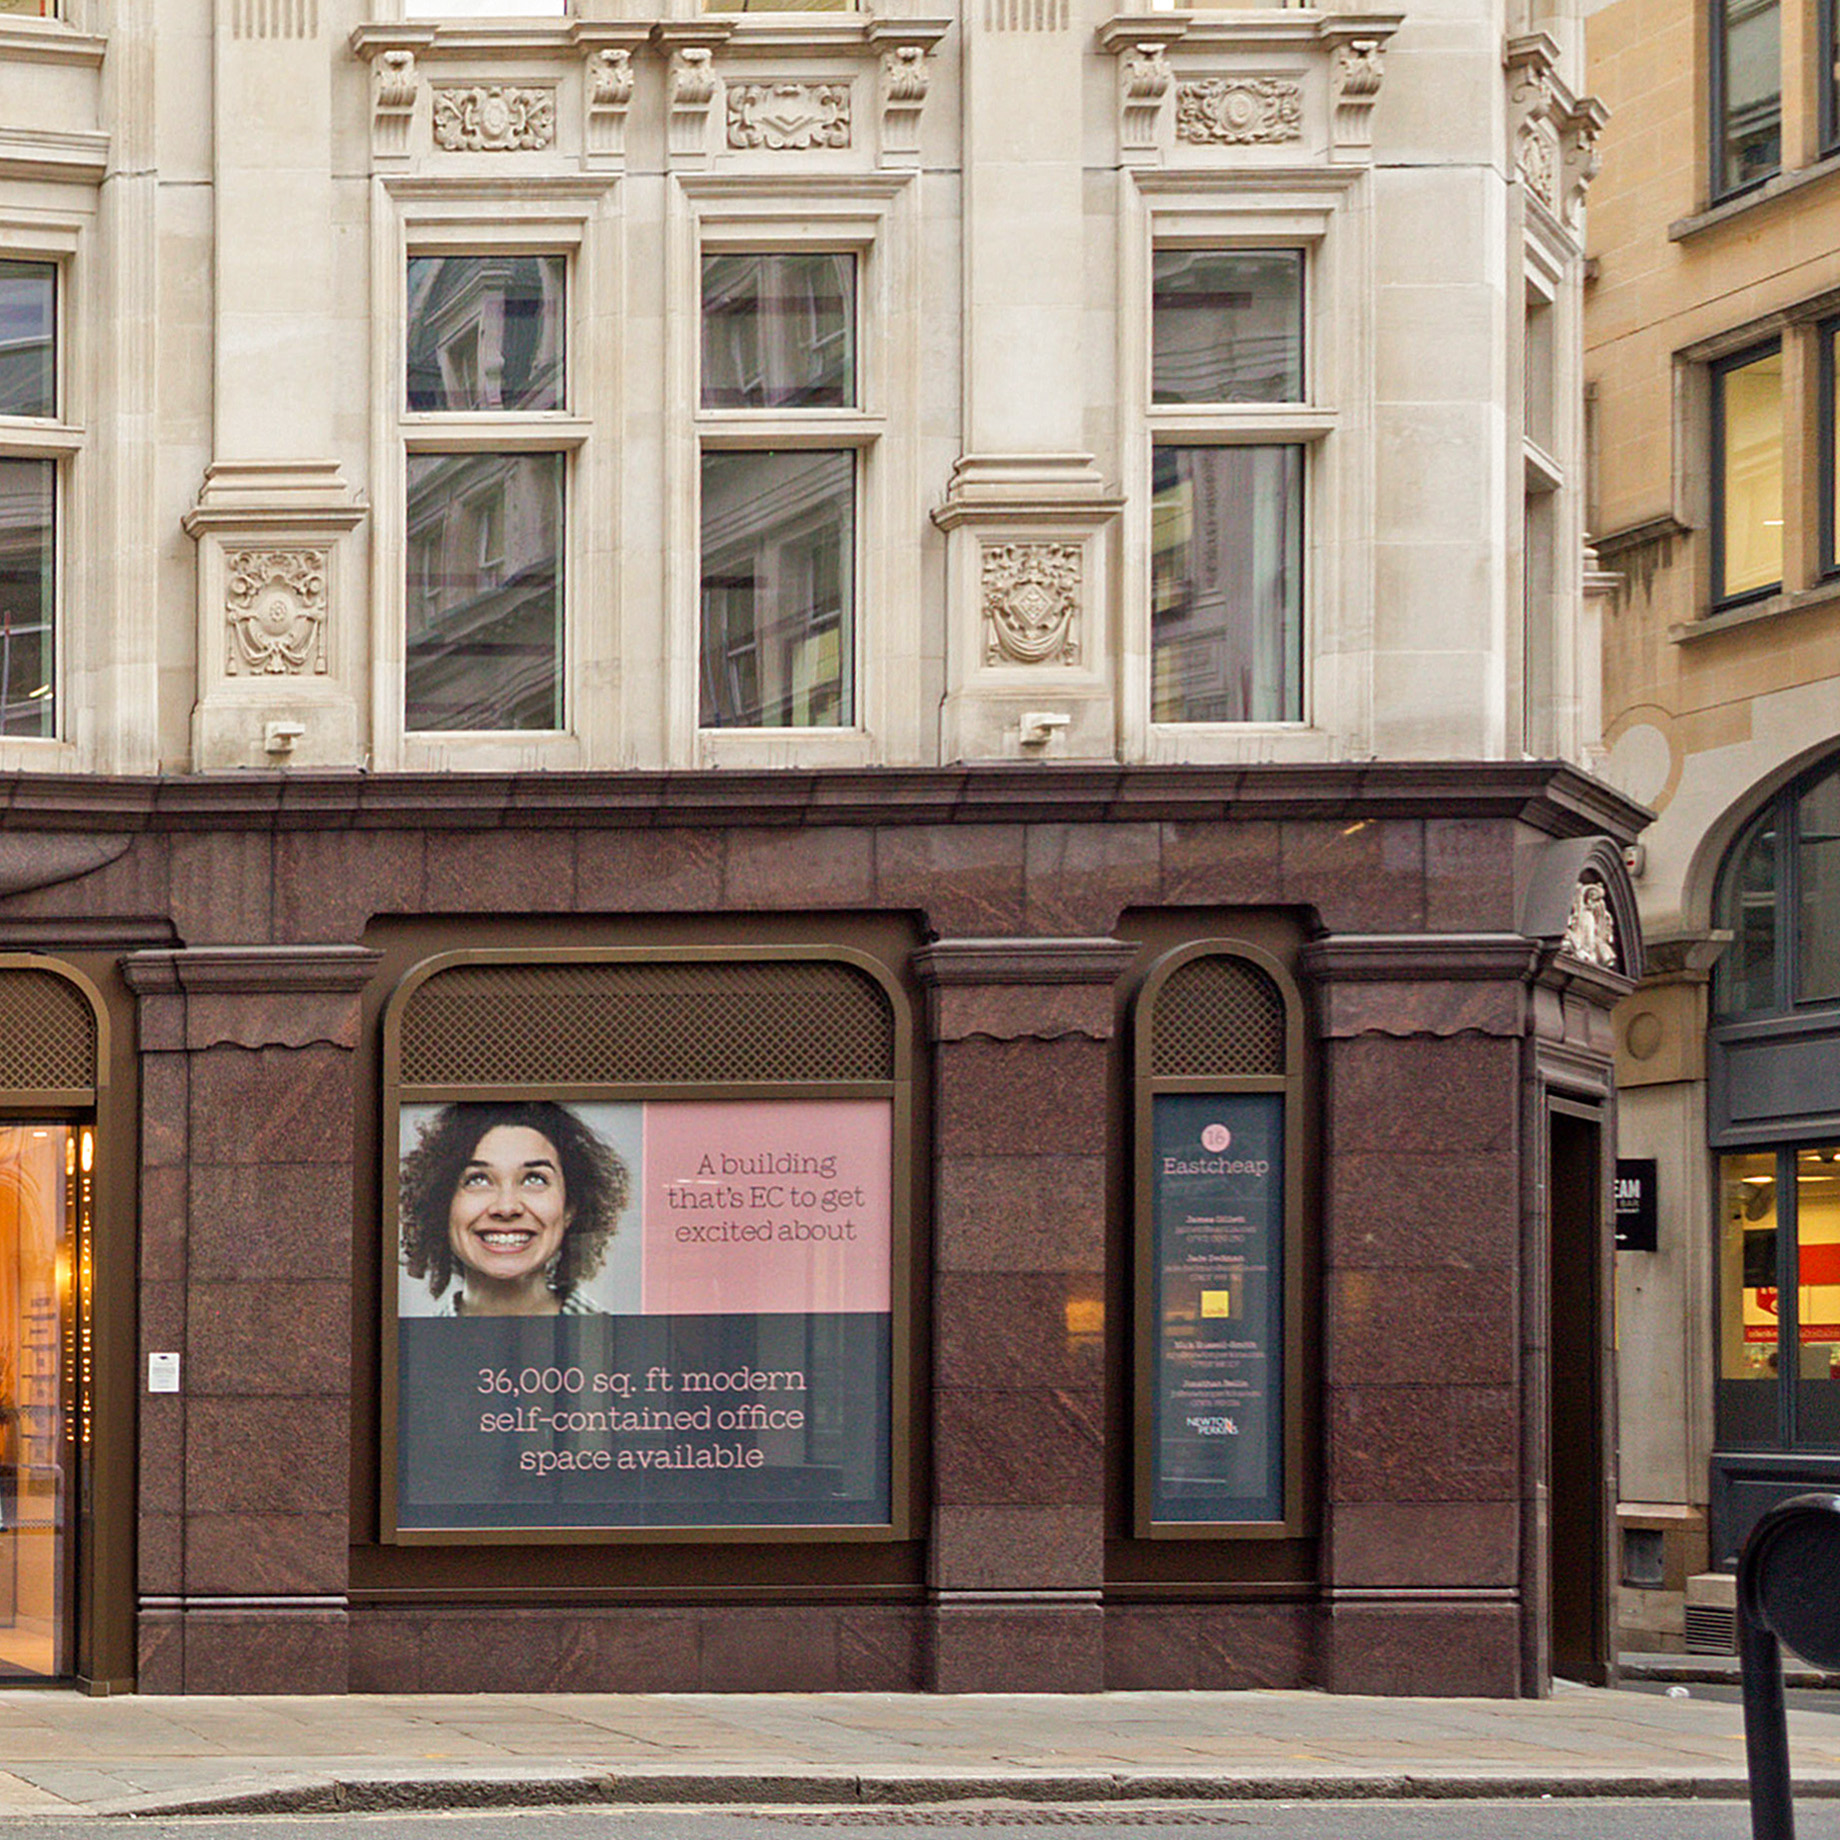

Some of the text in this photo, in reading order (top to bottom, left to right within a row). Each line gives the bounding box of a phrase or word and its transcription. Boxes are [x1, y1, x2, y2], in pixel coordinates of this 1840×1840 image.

[1206, 1130, 1226, 1146] 16
[697, 1152, 838, 1179] A building
[1163, 1157, 1270, 1177] Eastcheap
[667, 1186, 866, 1213] that's EC to get
[675, 1219, 857, 1242] excited about
[477, 1365, 808, 1398] 36,000 sq. ft modern
[480, 1403, 805, 1432] self-contained office
[520, 1443, 765, 1477] space available
